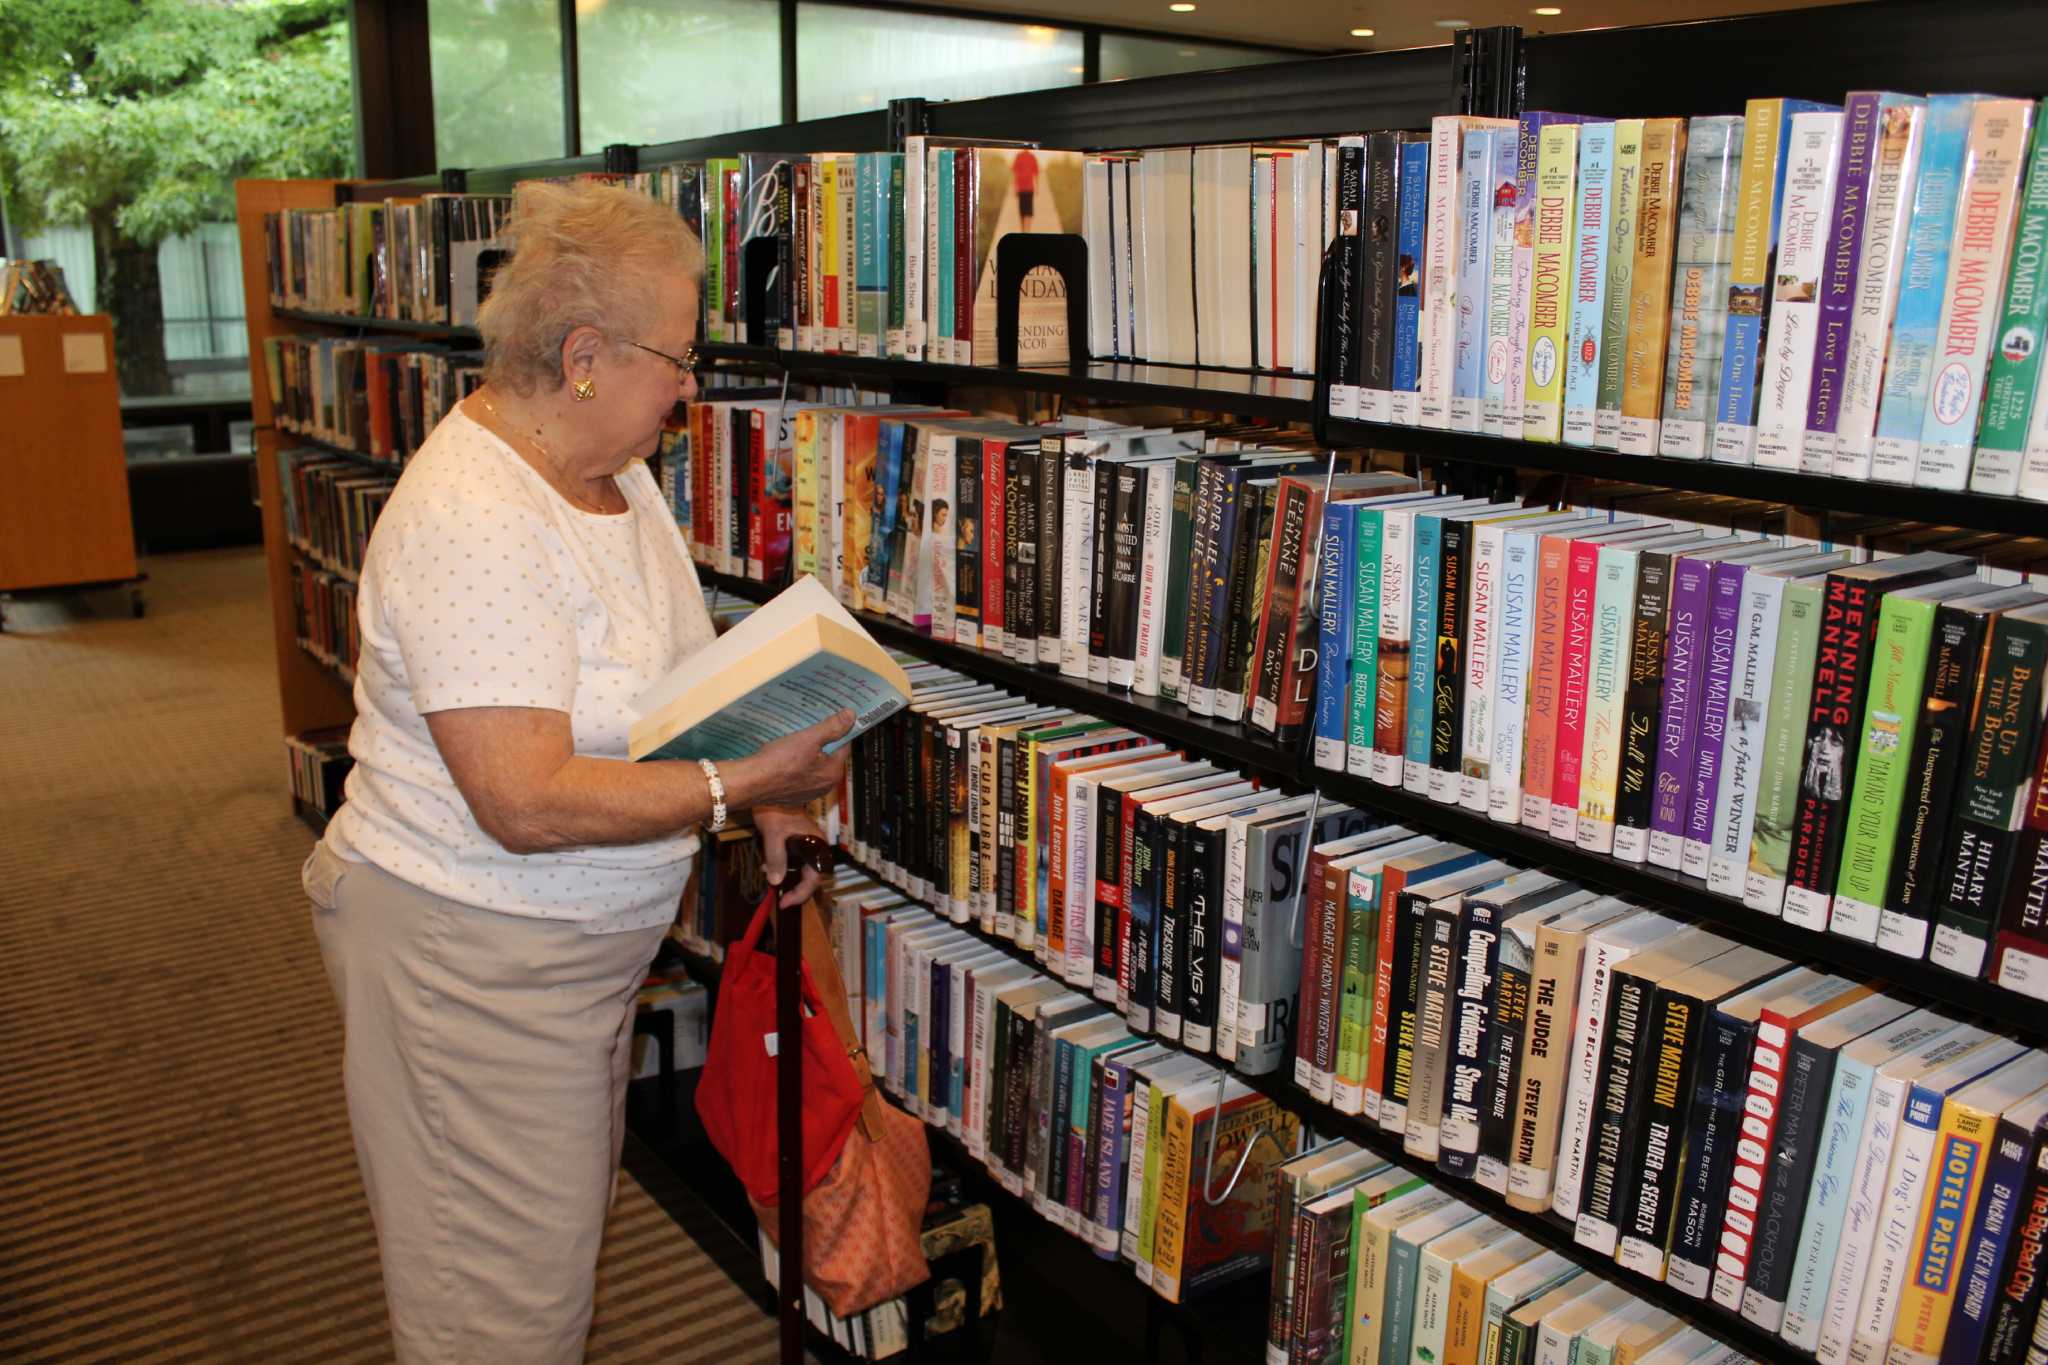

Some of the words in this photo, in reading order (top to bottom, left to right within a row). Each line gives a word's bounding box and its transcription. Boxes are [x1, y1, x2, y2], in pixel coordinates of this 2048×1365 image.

[1438, 131, 1449, 185] DEBBIE
[1517, 121, 1529, 196] MACOMBER
[1528, 135, 1537, 182] DEBBIE
[1753, 107, 1770, 169] DEBBIE
[1848, 104, 1871, 176] DEBBIE
[1650, 162, 1664, 198] DEBBIE
[1877, 147, 1902, 211] DEBBIE
[1539, 197, 1565, 246] DEBBIE
[1583, 187, 1603, 230] DEBBIE
[1646, 199, 1661, 258] MACOMBER
[1740, 179, 1763, 279] MACOMBER
[1783, 194, 1808, 268] MACOMBER
[1800, 211, 1818, 252] DEBBIE
[1962, 192, 2000, 253] DEBBIE
[1433, 196, 1447, 285] MACOMBER
[1833, 185, 1861, 295] MACOMBER
[2008, 214, 2048, 316] MACOMBER
[990, 279, 1067, 299] LNDAY
[1579, 234, 1600, 303] MACOMBER
[1862, 216, 1891, 315] MACOMBER
[1535, 253, 1561, 329] MACOMBER
[1683, 267, 1704, 321] DEBBIE
[1944, 258, 1990, 357] MACOMBER
[1824, 321, 1843, 361] Love
[1674, 325, 1697, 411] MACOMBER
[1815, 367, 1837, 426] Letters
[2010, 390, 2025, 420] 1225
[1198, 465, 1210, 524] HARPER
[1209, 471, 1225, 531] HARPER
[1193, 530, 1204, 558] LEE
[1207, 537, 1218, 567] LEE
[1280, 498, 1297, 573] LEHANE
[1288, 503, 1304, 576] DENNIS
[1417, 556, 1431, 612] SUSAN
[1445, 555, 1457, 590] SUSAN
[1474, 562, 1490, 614] SUSAN
[1443, 592, 1457, 640] MALLERY
[1505, 573, 1524, 627] SUSAN
[1541, 576, 1560, 635] SUSAN
[1569, 588, 1588, 645] SUSAN
[1599, 604, 1617, 646] SUSAN
[1265, 648, 1276, 675] DAY
[1279, 632, 1287, 653] THE
[1414, 617, 1428, 693] MALLERY
[1471, 618, 1487, 690] MALLERY
[1632, 619, 1649, 686] MALLERY
[1645, 631, 1660, 678] SUSAN
[1673, 611, 1693, 672] SUSAN
[1710, 626, 1733, 676] SUSAN
[1814, 581, 1846, 722] MANKELL
[1833, 586, 1866, 725] HENNING
[1500, 632, 1521, 705] MALLERY
[1536, 640, 1556, 718] MALLERY
[1563, 652, 1586, 730] MALLERY
[1595, 649, 1613, 703] MALLERY
[1935, 646, 1952, 696] MANSELL
[1948, 662, 1961, 686] JILL
[1664, 677, 1687, 758] MALLERY
[1702, 678, 1729, 742] MALLERY
[1987, 678, 2006, 710] THE
[2005, 666, 2032, 724] BRING
[1738, 736, 1749, 746] a
[1974, 715, 2002, 779] BODIES
[1998, 728, 2019, 756] UP
[981, 760, 991, 809] CUBA
[1731, 745, 1751, 791] fatal
[1863, 758, 1890, 806] MAKING
[1054, 792, 1064, 819] John
[1659, 807, 1676, 823] KIND
[1725, 792, 1745, 854] WINTER
[1856, 807, 1881, 839] YOUR
[981, 811, 991, 861] LIBRE
[1052, 822, 1064, 880] Lescroart
[1134, 835, 1145, 887] LESCROART
[1853, 842, 1878, 873] MIND
[1849, 874, 1871, 892] UP
[1949, 830, 1977, 903] MANTEL
[1967, 839, 1994, 906] HILARY
[1052, 888, 1064, 941] DAMAGE
[1193, 895, 1206, 948] THE
[1472, 916, 1490, 924] HALL
[1137, 938, 1147, 973] PLAGUE
[1163, 914, 1175, 970] TREASURE
[1427, 944, 1450, 989] STEVE
[1458, 929, 1496, 1000] Compelling
[1544, 941, 1559, 949] LARGE
[1544, 948, 1558, 957] PRINT
[1161, 973, 1173, 1004] HUNT
[1190, 956, 1204, 996] VIG
[1498, 971, 1515, 1024] MARTINI
[1537, 978, 1556, 1007] THE
[1421, 988, 1445, 1049] MARTINI
[1511, 983, 1528, 1021] STEVE
[1616, 984, 1642, 1045] SHADOW
[1662, 1001, 1689, 1046] STEVE
[1399, 1010, 1416, 1047] STEVE
[1457, 1002, 1488, 1059] Evidence
[1501, 1034, 1514, 1053] THE
[1531, 1007, 1553, 1059] JUDGE
[1393, 1048, 1414, 1100] MARTINI
[1497, 1053, 1512, 1086] ENEMY
[1612, 1046, 1633, 1065] OF
[1653, 1044, 1683, 1109] MARTINI
[1453, 1064, 1482, 1103] Steve
[1493, 1087, 1508, 1120] INSIDE
[1605, 1065, 1630, 1114] POWER
[1911, 1099, 1933, 1114] LARGE
[1104, 1097, 1117, 1134] JADE
[1574, 1100, 1588, 1135] STEVE
[1909, 1110, 1930, 1124] PRINT
[1957, 1117, 1982, 1129] LARGE
[1098, 1137, 1114, 1189] ISLAND
[1569, 1138, 1582, 1181] MARTIN
[1598, 1122, 1621, 1163] STEVE
[1645, 1122, 1670, 1171] TRADER
[1904, 1147, 1921, 1163] A
[2001, 1139, 2024, 1153] LARGE
[1163, 1132, 1178, 1204] LOWELL
[1590, 1162, 1616, 1220] MARTINI
[1643, 1171, 1659, 1184] OF
[1891, 1168, 1918, 1214] Dog's
[1940, 1141, 1972, 1210] HOTEL
[1636, 1183, 1660, 1236] SECRETS
[1684, 1197, 1700, 1246] MASON
[1883, 1218, 1907, 1253] Life
[1923, 1216, 1956, 1287] PASTIS
[1880, 1257, 1895, 1293] PETER
[1869, 1295, 1886, 1334] MAYLE
[1916, 1294, 1936, 1332] PETER
